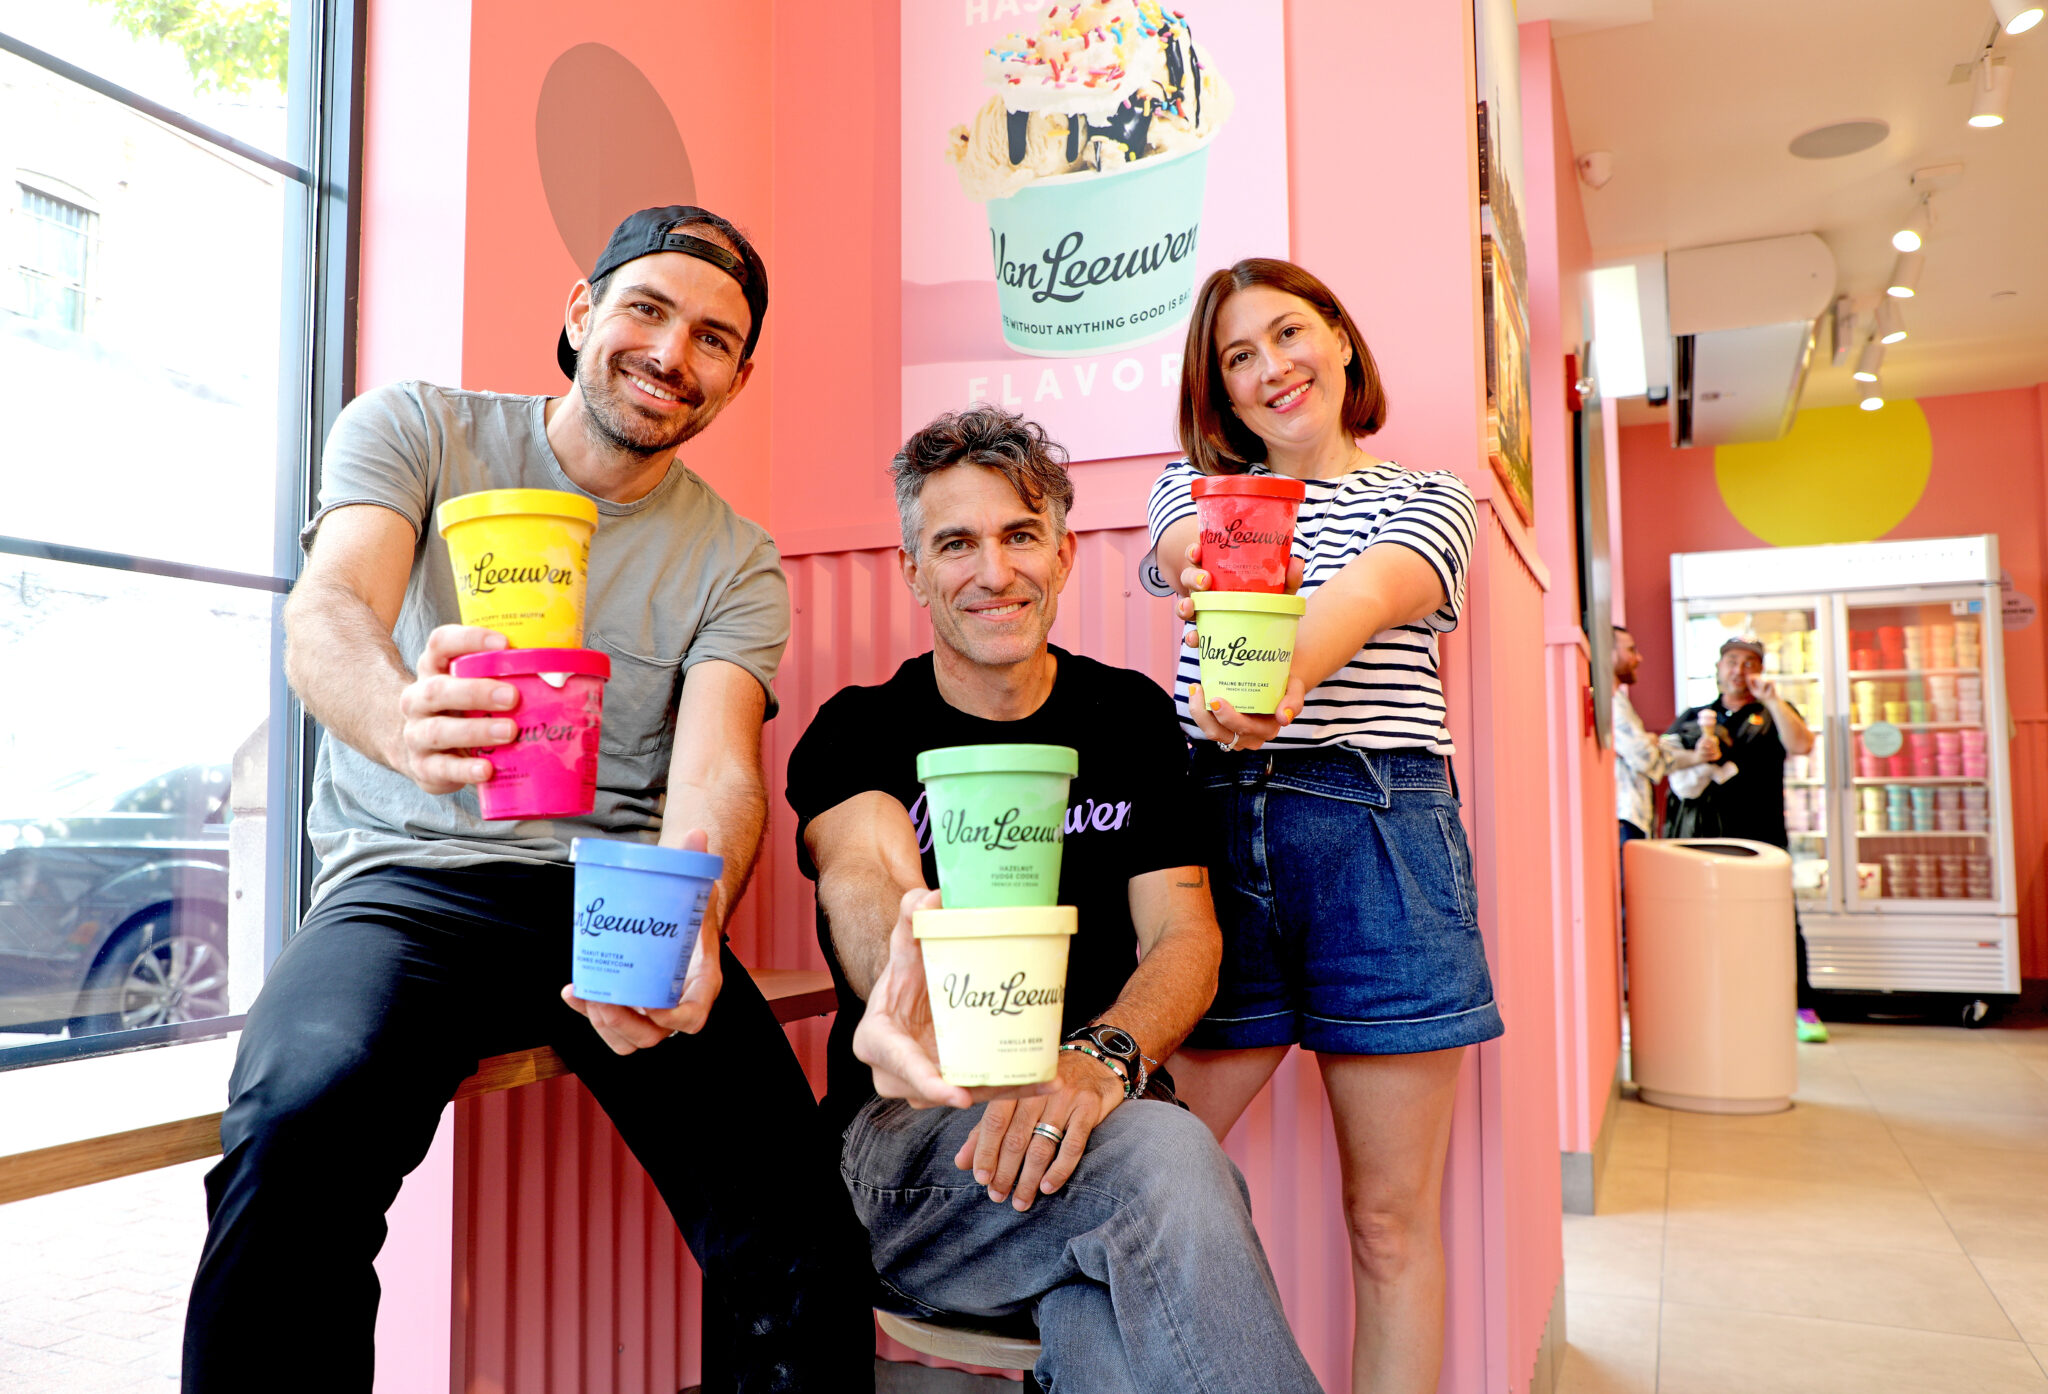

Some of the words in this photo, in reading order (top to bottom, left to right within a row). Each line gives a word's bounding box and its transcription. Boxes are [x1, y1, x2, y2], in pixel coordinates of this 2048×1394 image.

[990, 227, 1043, 290] Van
[1032, 223, 1198, 303] Leeuwen
[1010, 319, 1053, 335] WITHOUT
[1056, 316, 1125, 335] ANYTHING
[1129, 304, 1166, 324] GOOD
[1168, 298, 1177, 311] IS
[1219, 519, 1289, 549] Leeuwen
[472, 552, 573, 595] Leeuwen
[1200, 635, 1227, 660] Van
[1222, 636, 1290, 666] Leeuwen
[942, 808, 993, 845] Van
[984, 808, 1064, 851] Leeuw
[581, 897, 679, 938] Leeuwen
[943, 972, 997, 1008] Van
[990, 971, 1066, 1016] Leeuw
